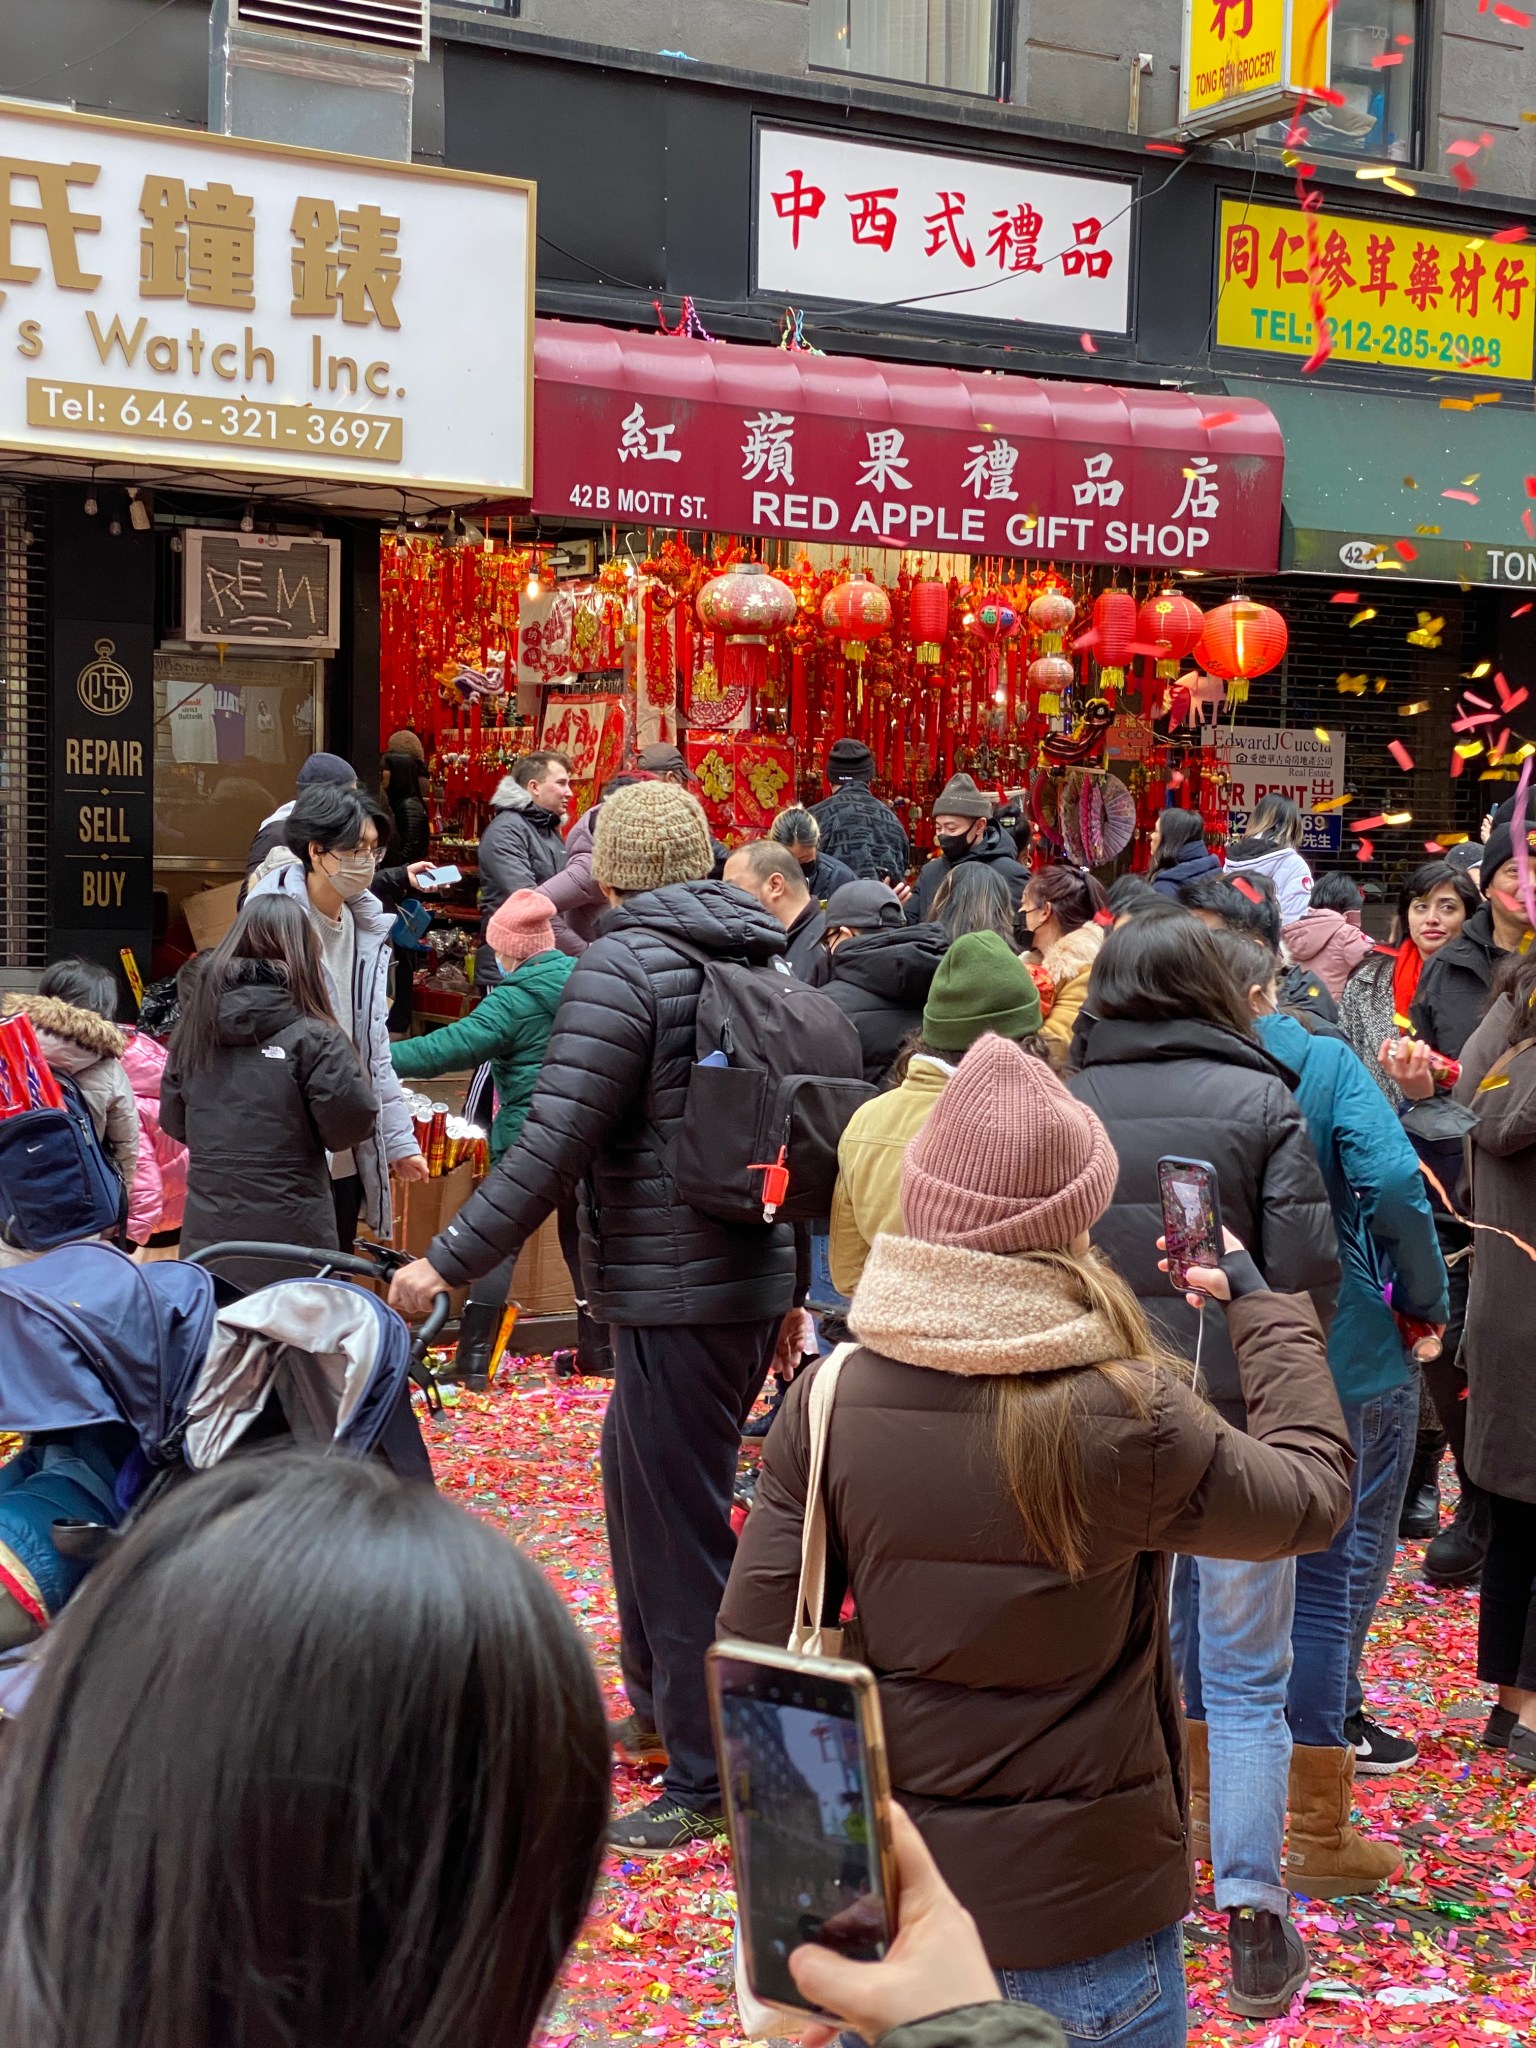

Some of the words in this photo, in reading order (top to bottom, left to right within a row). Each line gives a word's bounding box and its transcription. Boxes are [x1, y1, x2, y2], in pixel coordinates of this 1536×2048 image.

[1196, 71, 1218, 97] TONG
[1219, 62, 1236, 89] REN
[1237, 50, 1277, 84] GROCERY
[770, 169, 1114, 280] 中西式禮品
[1225, 223, 1530, 321] 同仁參茸藥材行
[1250, 308, 1313, 346] TEL:
[85, 310, 276, 383] Watch
[312, 334, 407, 399] Inc.
[41, 386, 106, 423] Tel:
[617, 402, 1220, 520] 紅蘋果禮品店
[618, 488, 675, 517] MOTT
[680, 495, 708, 519] ST.
[752, 491, 840, 530] RED
[850, 500, 985, 543] APPLE
[1005, 513, 1094, 551] GIFT
[1104, 520, 1210, 558] SHOP
[66, 739, 143, 777] REPAIR
[1288, 768, 1306, 778] Real
[1308, 769, 1331, 778] Estate
[79, 806, 131, 844] SELL
[82, 870, 126, 908] BUY
